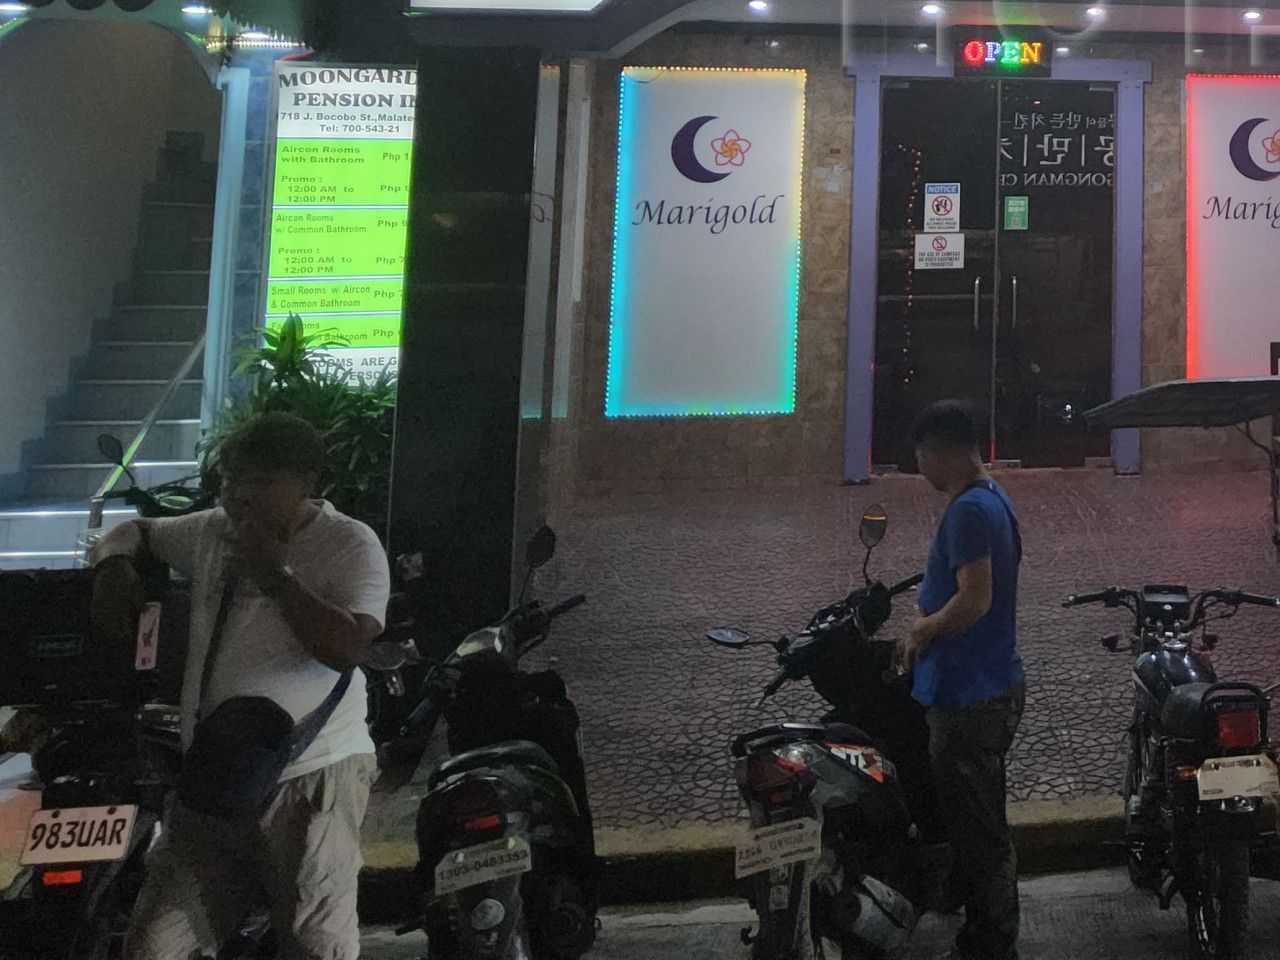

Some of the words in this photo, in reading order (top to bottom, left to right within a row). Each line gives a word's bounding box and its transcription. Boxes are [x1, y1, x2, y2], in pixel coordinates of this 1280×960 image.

[963, 40, 1042, 63] OPEN
[292, 92, 394, 108] PENSION
[303, 113, 313, 121] J.
[316, 112, 357, 122] Bocobo
[319, 124, 339, 132] Tel:
[342, 124, 401, 133] 700-543-21
[281, 145, 319, 154] Aircon
[322, 146, 361, 154] Rooms
[281, 156, 306, 164] with
[309, 156, 365, 164] Bathroom
[382, 152, 401, 162] Php
[281, 175, 316, 183] Promo
[287, 185, 317, 193] 12:00
[319, 185, 337, 193] AM
[380, 184, 401, 193] Php
[928, 185, 958, 193] NOTICE
[287, 195, 316, 203] 12:00
[319, 195, 336, 203] PM
[276, 214, 304, 222] Aircon
[306, 214, 334, 222] Rooms
[632, 194, 785, 235] Marigold
[377, 219, 398, 229] Php
[287, 225, 324, 234] Common
[326, 225, 367, 234] Bathroom
[278, 247, 313, 255] Promo
[284, 256, 314, 264] 12:00
[317, 256, 335, 264] AM
[376, 256, 396, 265] Php
[284, 266, 314, 274] 12:00
[271, 286, 296, 295] Small
[298, 286, 327, 294] Rooms
[343, 285, 371, 294] Aircon
[373, 289, 395, 299] Php
[270, 300, 278, 309] &
[280, 300, 318, 308] Common
[320, 298, 361, 308] Bathroom
[372, 328, 394, 338] Php
[360, 356, 386, 367] ARE
[29, 817, 128, 852] 983UAR
